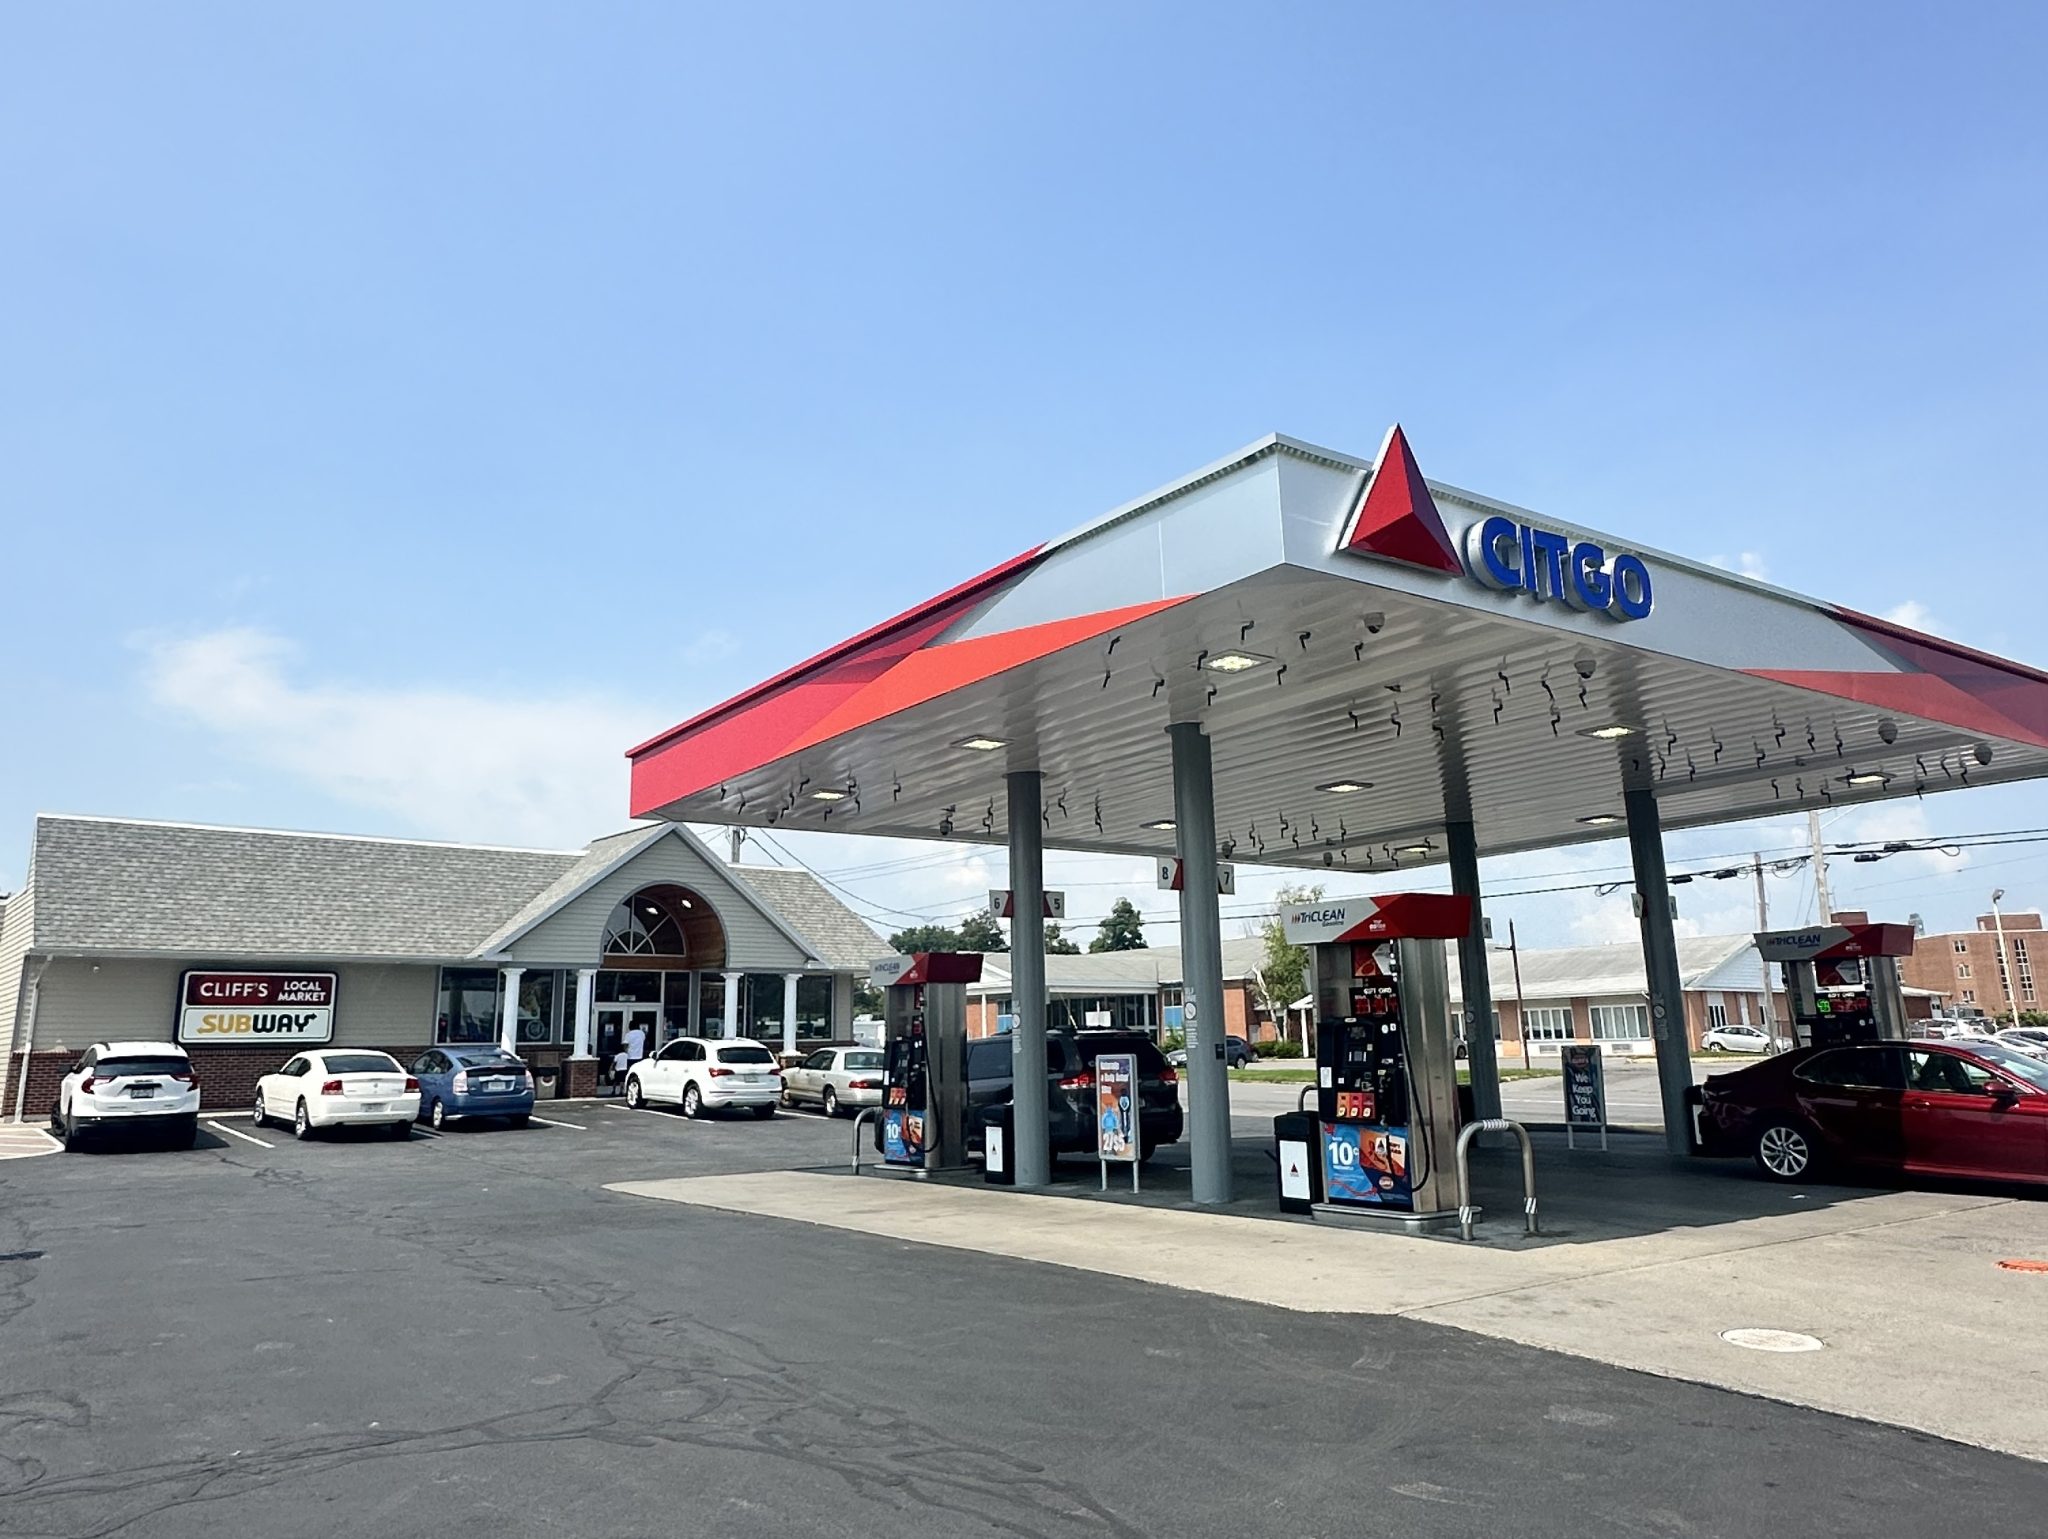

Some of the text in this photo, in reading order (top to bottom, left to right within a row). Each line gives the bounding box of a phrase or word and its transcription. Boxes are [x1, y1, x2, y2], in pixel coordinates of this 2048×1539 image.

[1468, 516, 1654, 622] CITGO
[1161, 866, 1169, 880] 8
[1223, 872, 1230, 885] 7
[993, 897, 1001, 910] 6
[1053, 897, 1061, 910] 5
[1300, 907, 1346, 924] TriCLEAN
[200, 982, 268, 998] CLIFF'S
[283, 981, 322, 991] LOCAL
[277, 991, 327, 1002] MARKET
[196, 1013, 318, 1034] SUBWAY
[1572, 1084, 1594, 1095] Keep
[1574, 1095, 1592, 1105] You
[1572, 1105, 1597, 1118] Going
